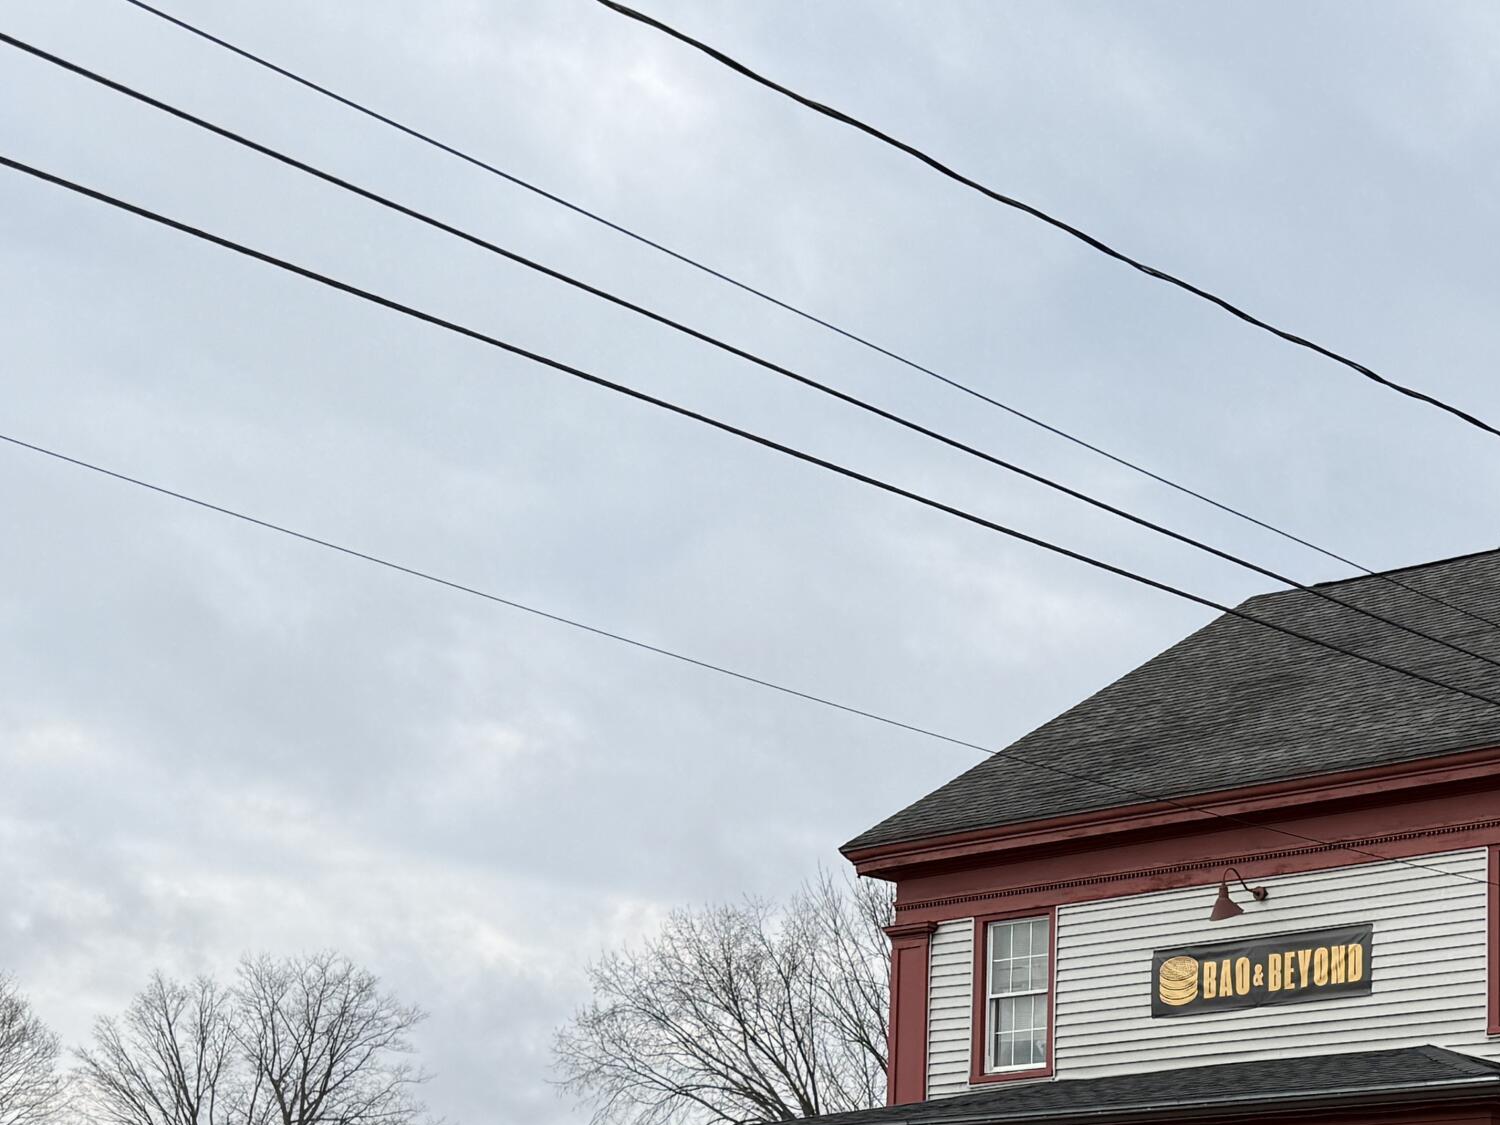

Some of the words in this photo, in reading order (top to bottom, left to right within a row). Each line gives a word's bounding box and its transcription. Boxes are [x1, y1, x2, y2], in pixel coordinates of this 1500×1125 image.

[1203, 957, 1250, 999] BAO
[1253, 964, 1264, 987] &
[1268, 943, 1363, 992] BEYOND
